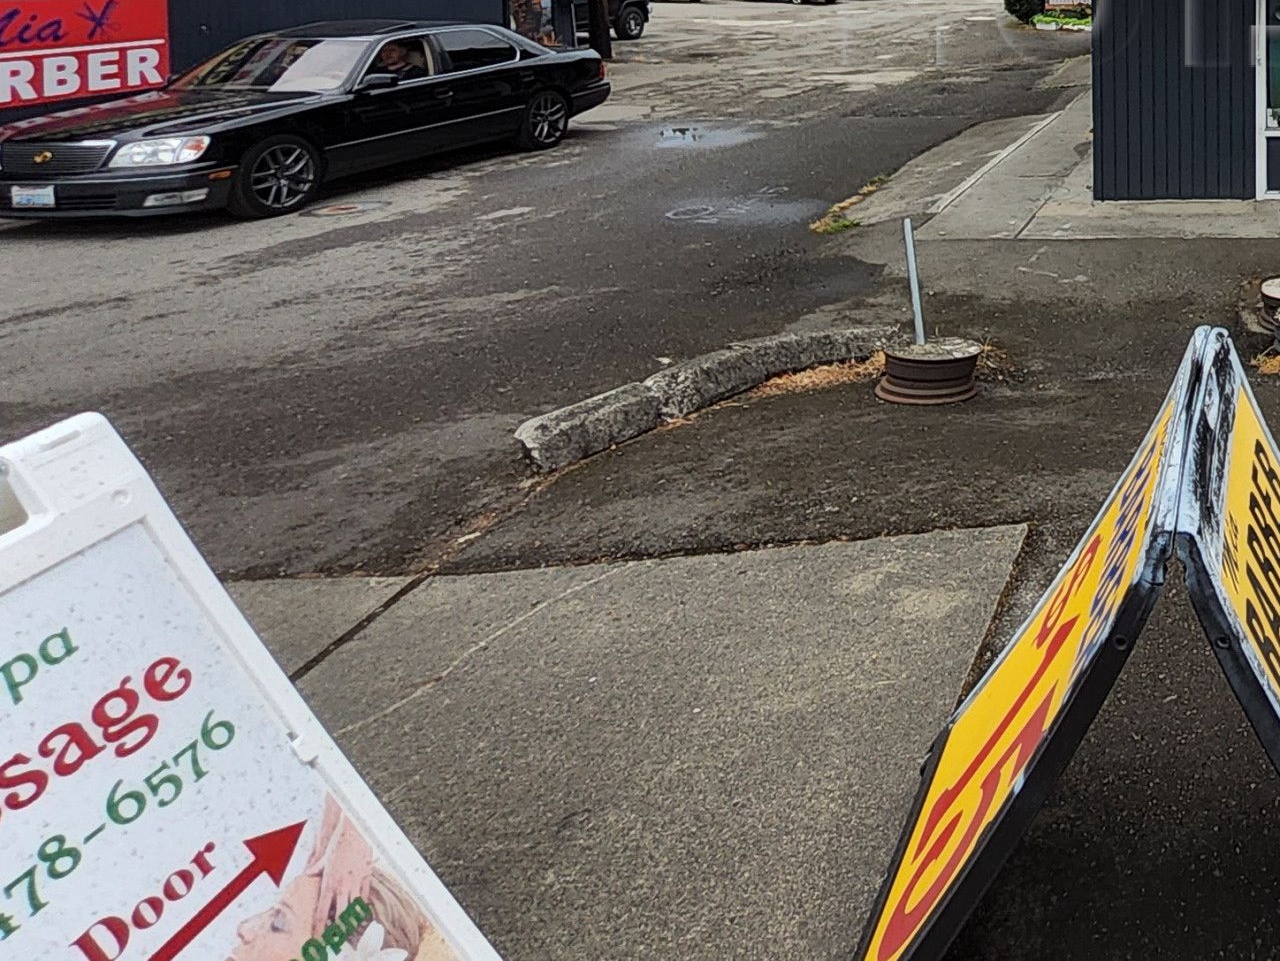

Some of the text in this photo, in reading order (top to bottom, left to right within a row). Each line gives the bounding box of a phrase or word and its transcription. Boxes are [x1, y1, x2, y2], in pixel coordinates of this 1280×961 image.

[0, 48, 164, 103] RBER
[0, 626, 80, 706] pa
[0, 656, 193, 811] sage
[68, 841, 217, 961] Door
[290, 895, 373, 961] 0pm
